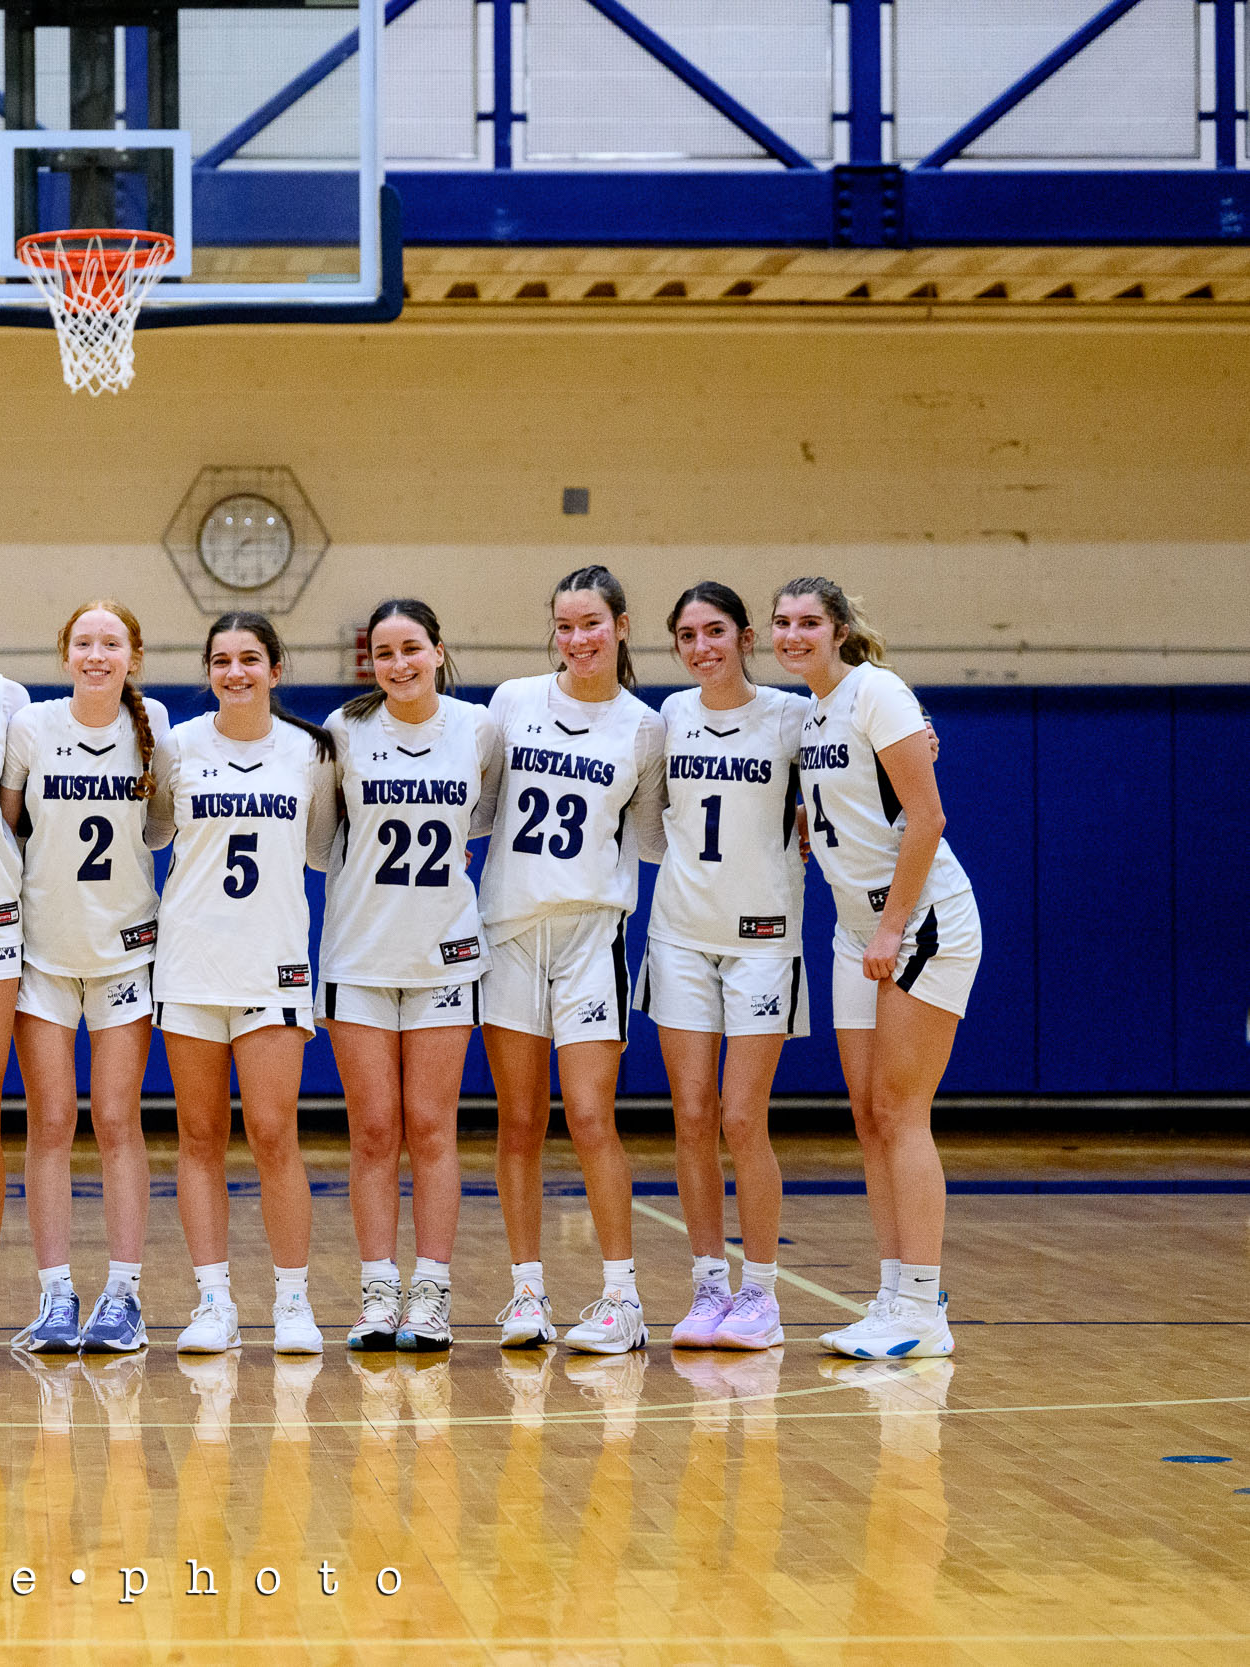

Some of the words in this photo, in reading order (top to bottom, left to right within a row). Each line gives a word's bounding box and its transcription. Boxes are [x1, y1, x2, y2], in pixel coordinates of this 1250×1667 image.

[43, 774, 144, 801] MUSTANG
[362, 779, 467, 806] MUSTANGS
[511, 747, 615, 786] MUSTANGS
[670, 756, 771, 784] MUSTANGS
[191, 793, 297, 820] MUSTANGS
[513, 787, 587, 859] 23
[700, 795, 722, 862] 1
[813, 784, 838, 847] 4
[77, 816, 113, 881] 2
[223, 833, 259, 898] 5
[376, 820, 451, 887] 22
